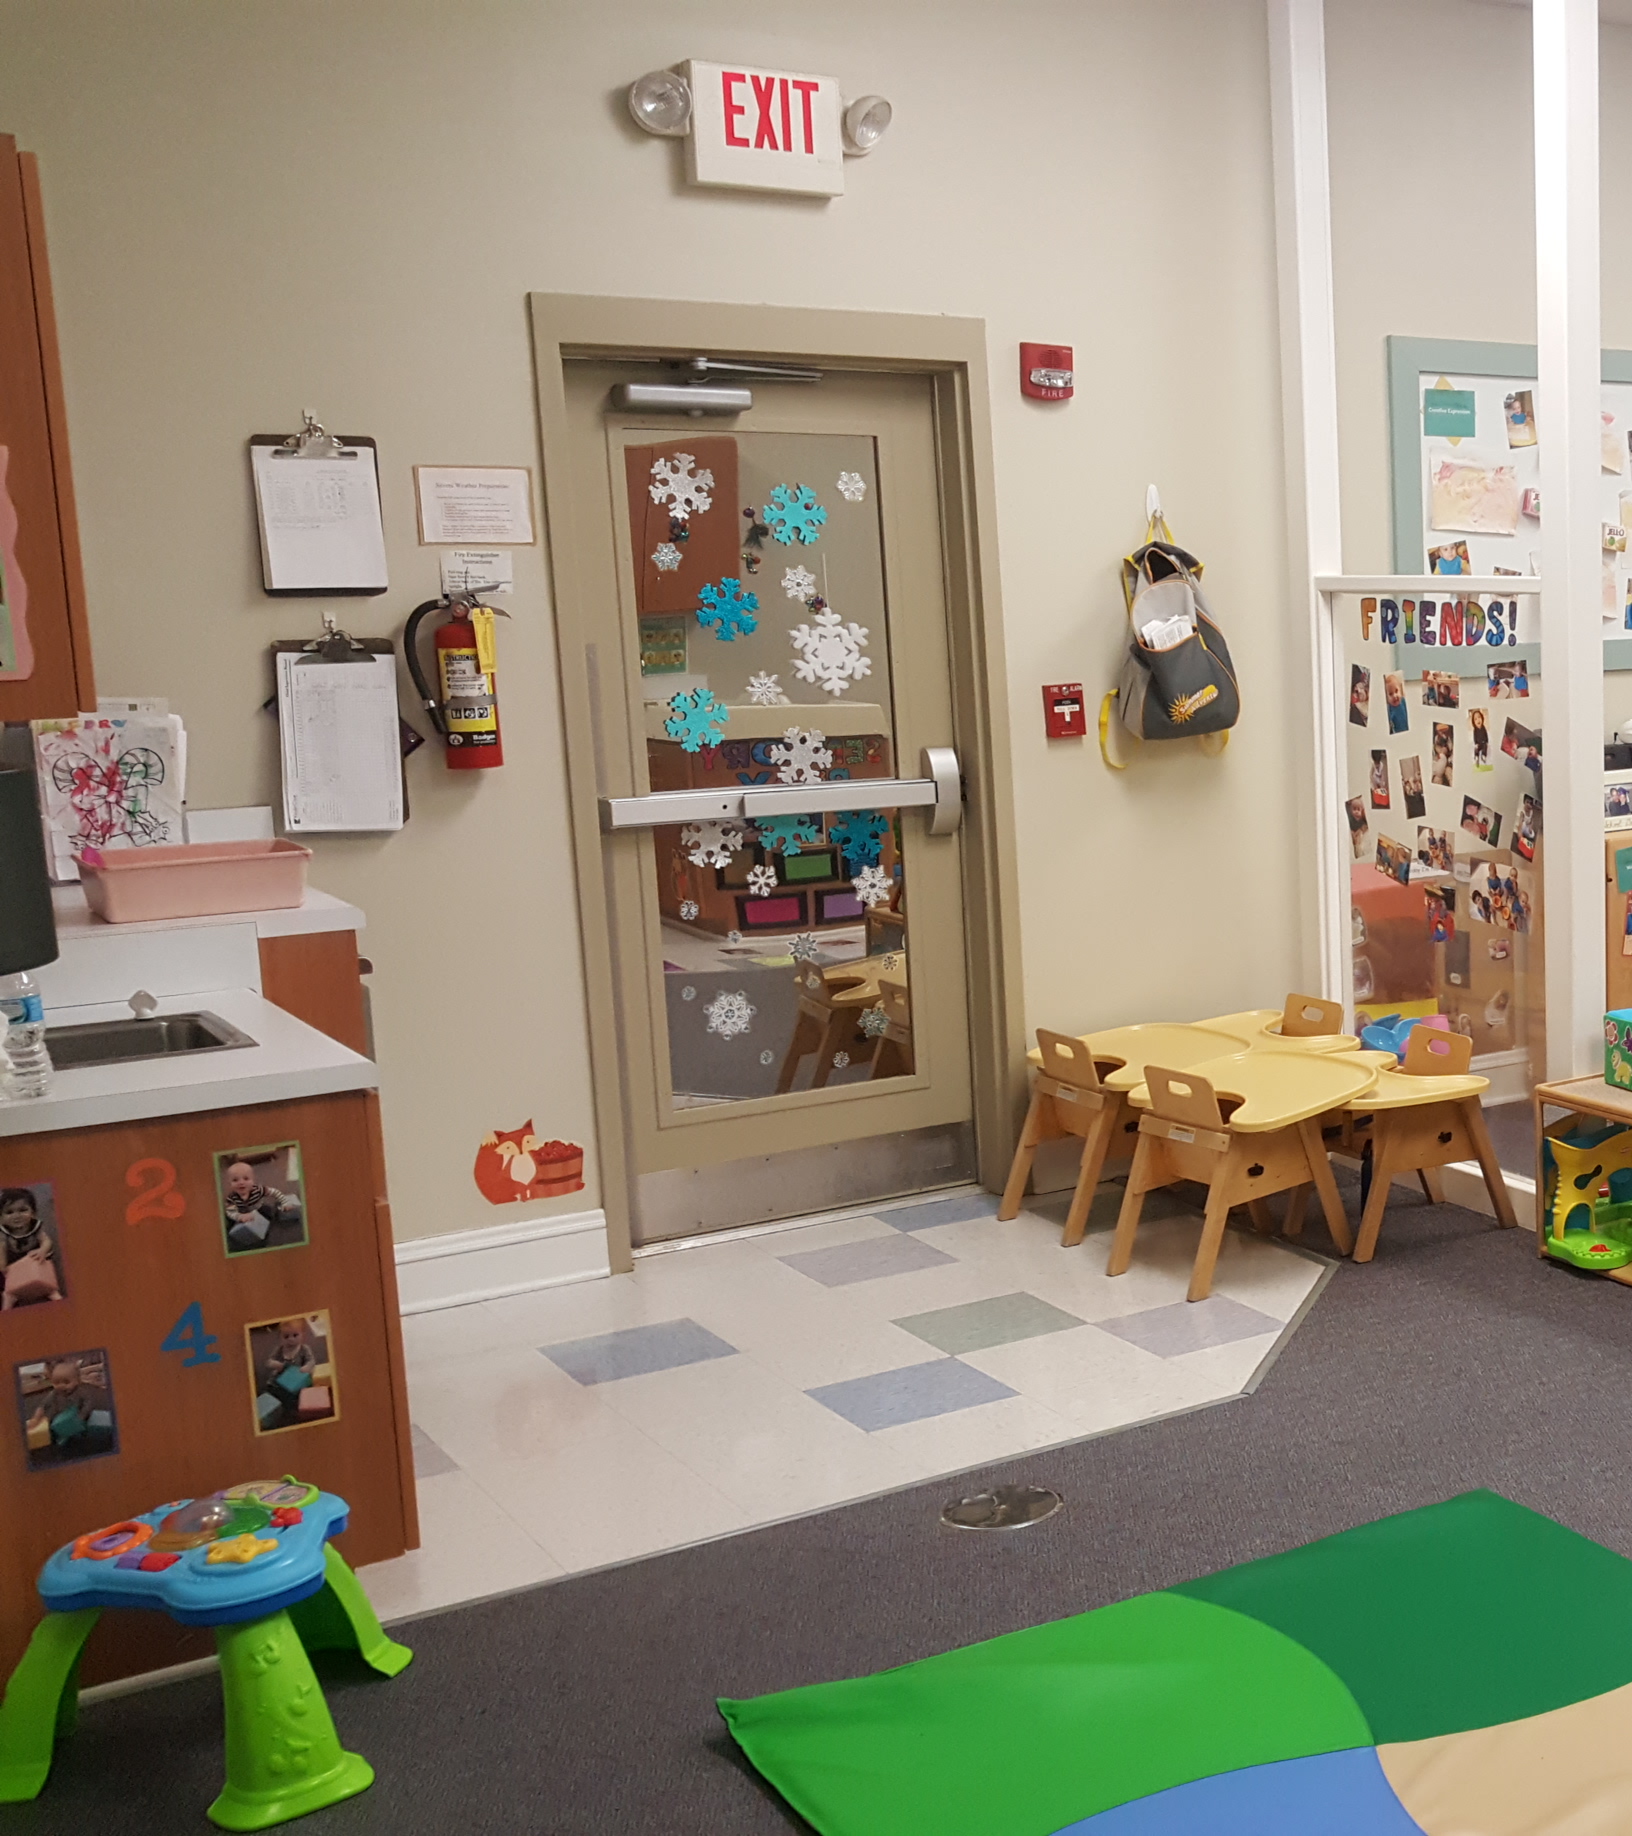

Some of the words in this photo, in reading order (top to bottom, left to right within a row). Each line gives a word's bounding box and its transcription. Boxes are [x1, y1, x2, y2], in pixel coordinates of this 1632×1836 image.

[721, 70, 819, 155] EXIT
[1041, 388, 1064, 398] FIRE
[1360, 597, 1518, 647] FRIENDS!
[125, 1157, 187, 1226] 2
[160, 1300, 222, 1368] 4
